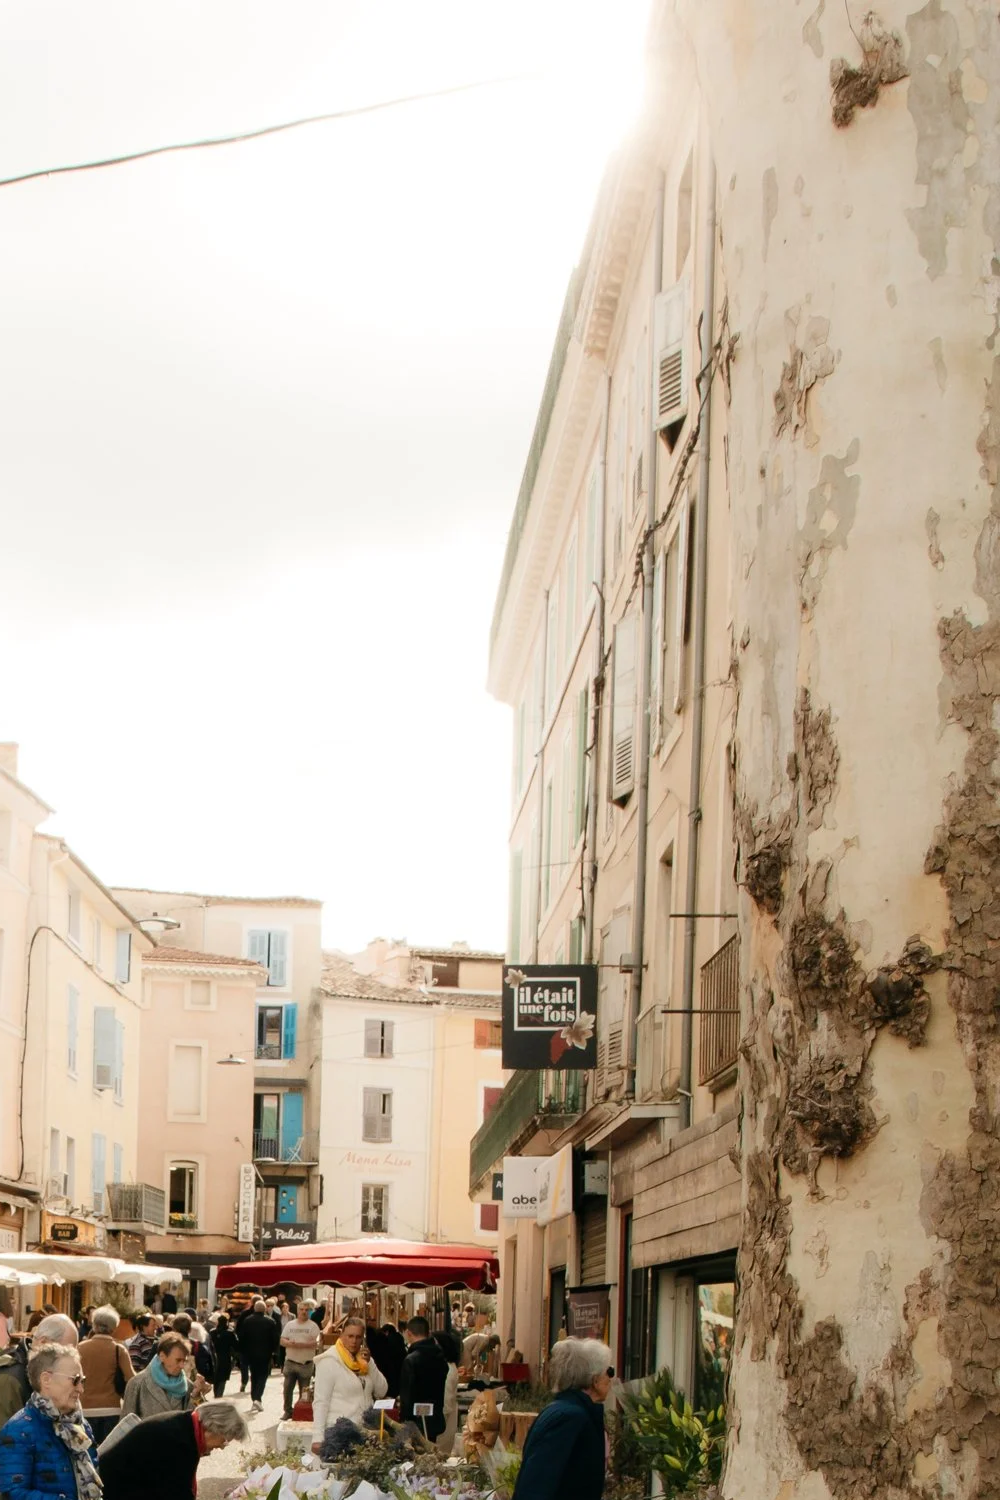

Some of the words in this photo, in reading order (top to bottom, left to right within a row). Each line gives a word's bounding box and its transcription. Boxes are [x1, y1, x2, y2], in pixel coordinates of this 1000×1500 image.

[519, 986, 531, 1004] il
[533, 986, 576, 1004] était
[519, 1004, 544, 1014] une
[543, 1004, 576, 1023] fois
[339, 1151, 379, 1166] Mona
[383, 1152, 412, 1167] Lisa
[242, 1166, 252, 1240] BOUCHERIE
[57, 1230, 71, 1238] BAR
[274, 1228, 310, 1242] Palais
